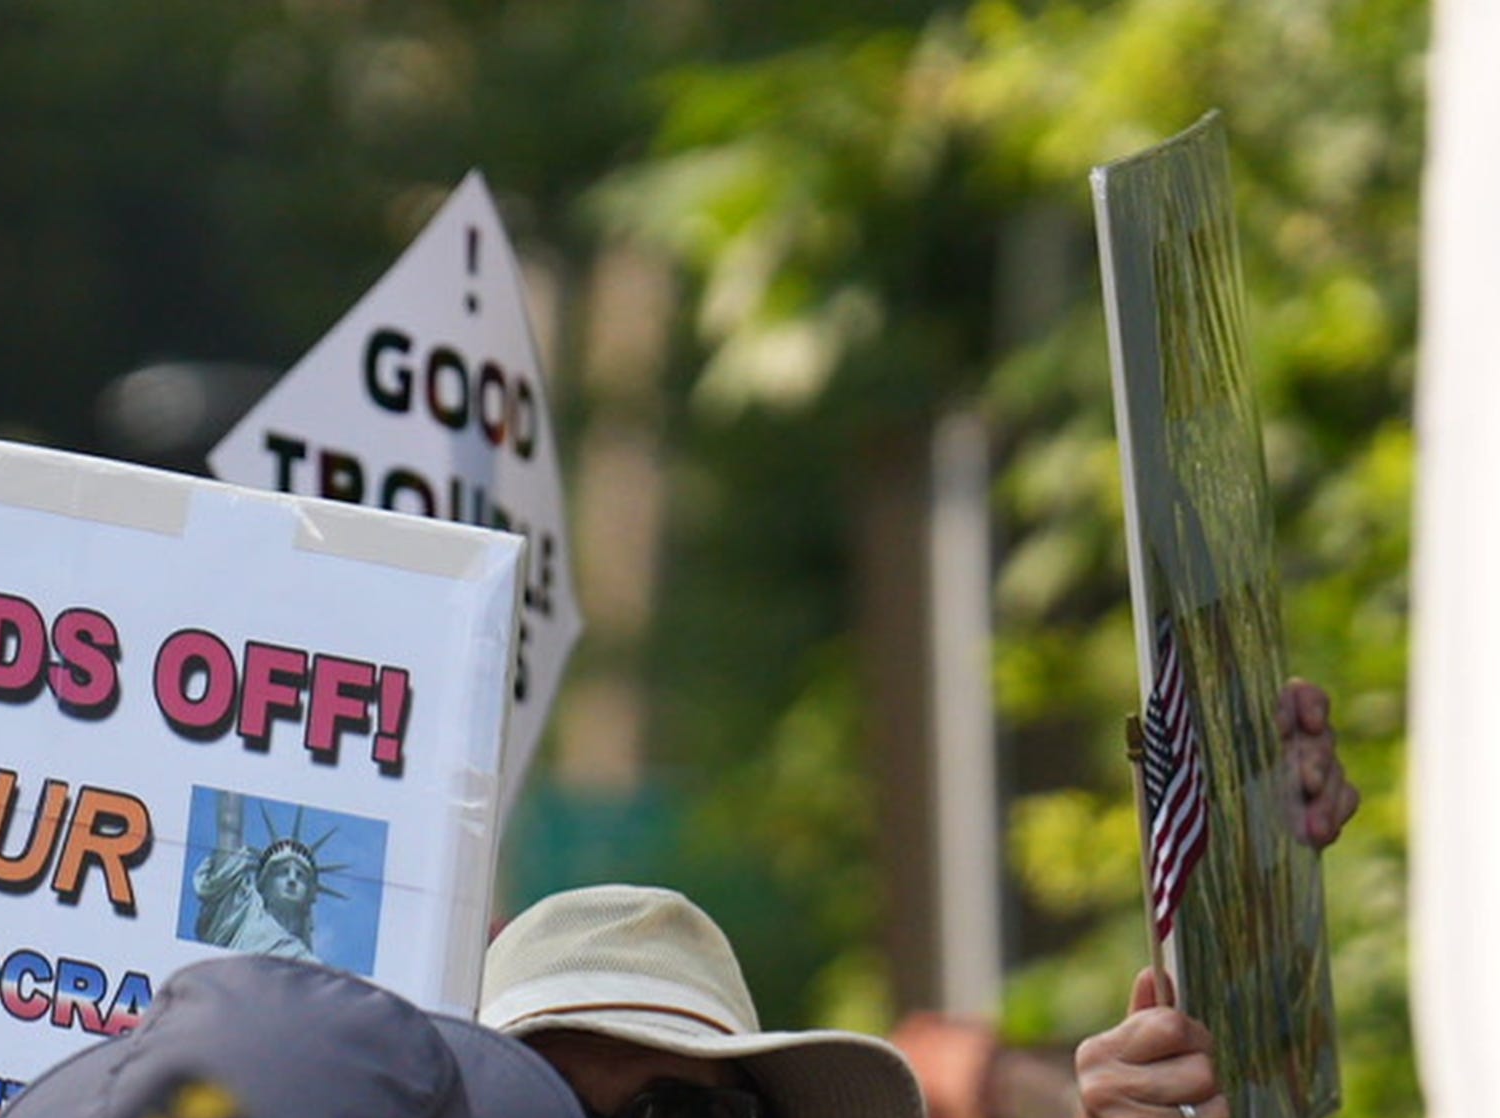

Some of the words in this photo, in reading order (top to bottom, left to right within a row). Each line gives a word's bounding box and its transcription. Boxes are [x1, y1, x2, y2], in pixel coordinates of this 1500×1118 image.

[465, 226, 481, 313] !
[363, 327, 538, 461] GOOD
[264, 430, 554, 617] TROE
[152, 628, 411, 779] OFF!
